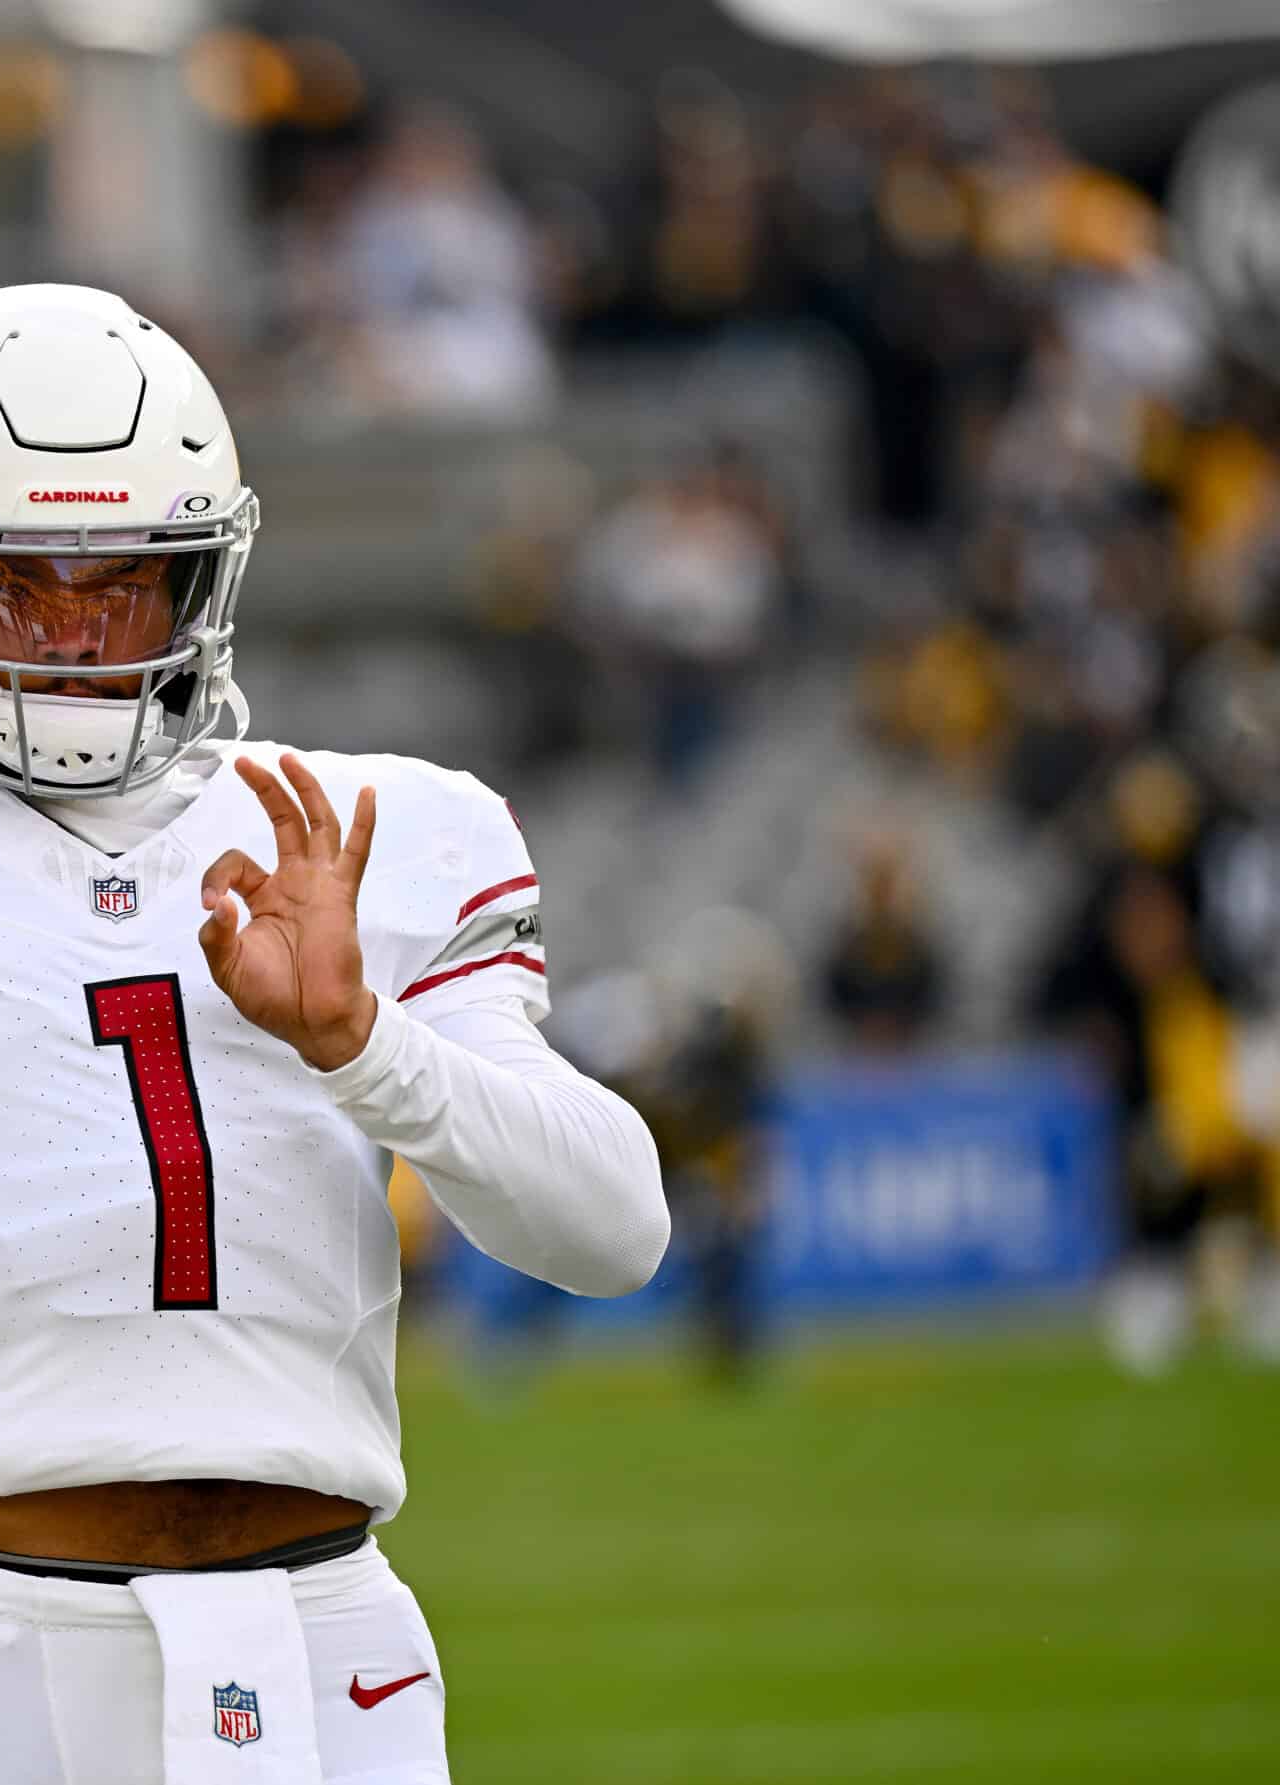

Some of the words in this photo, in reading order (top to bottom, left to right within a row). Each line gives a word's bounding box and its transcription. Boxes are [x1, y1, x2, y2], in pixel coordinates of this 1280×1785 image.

[28, 491, 129, 503] CARDINALS
[98, 893, 133, 912] NFL
[82, 972, 219, 1312] 1
[218, 1708, 257, 1741] NFL
